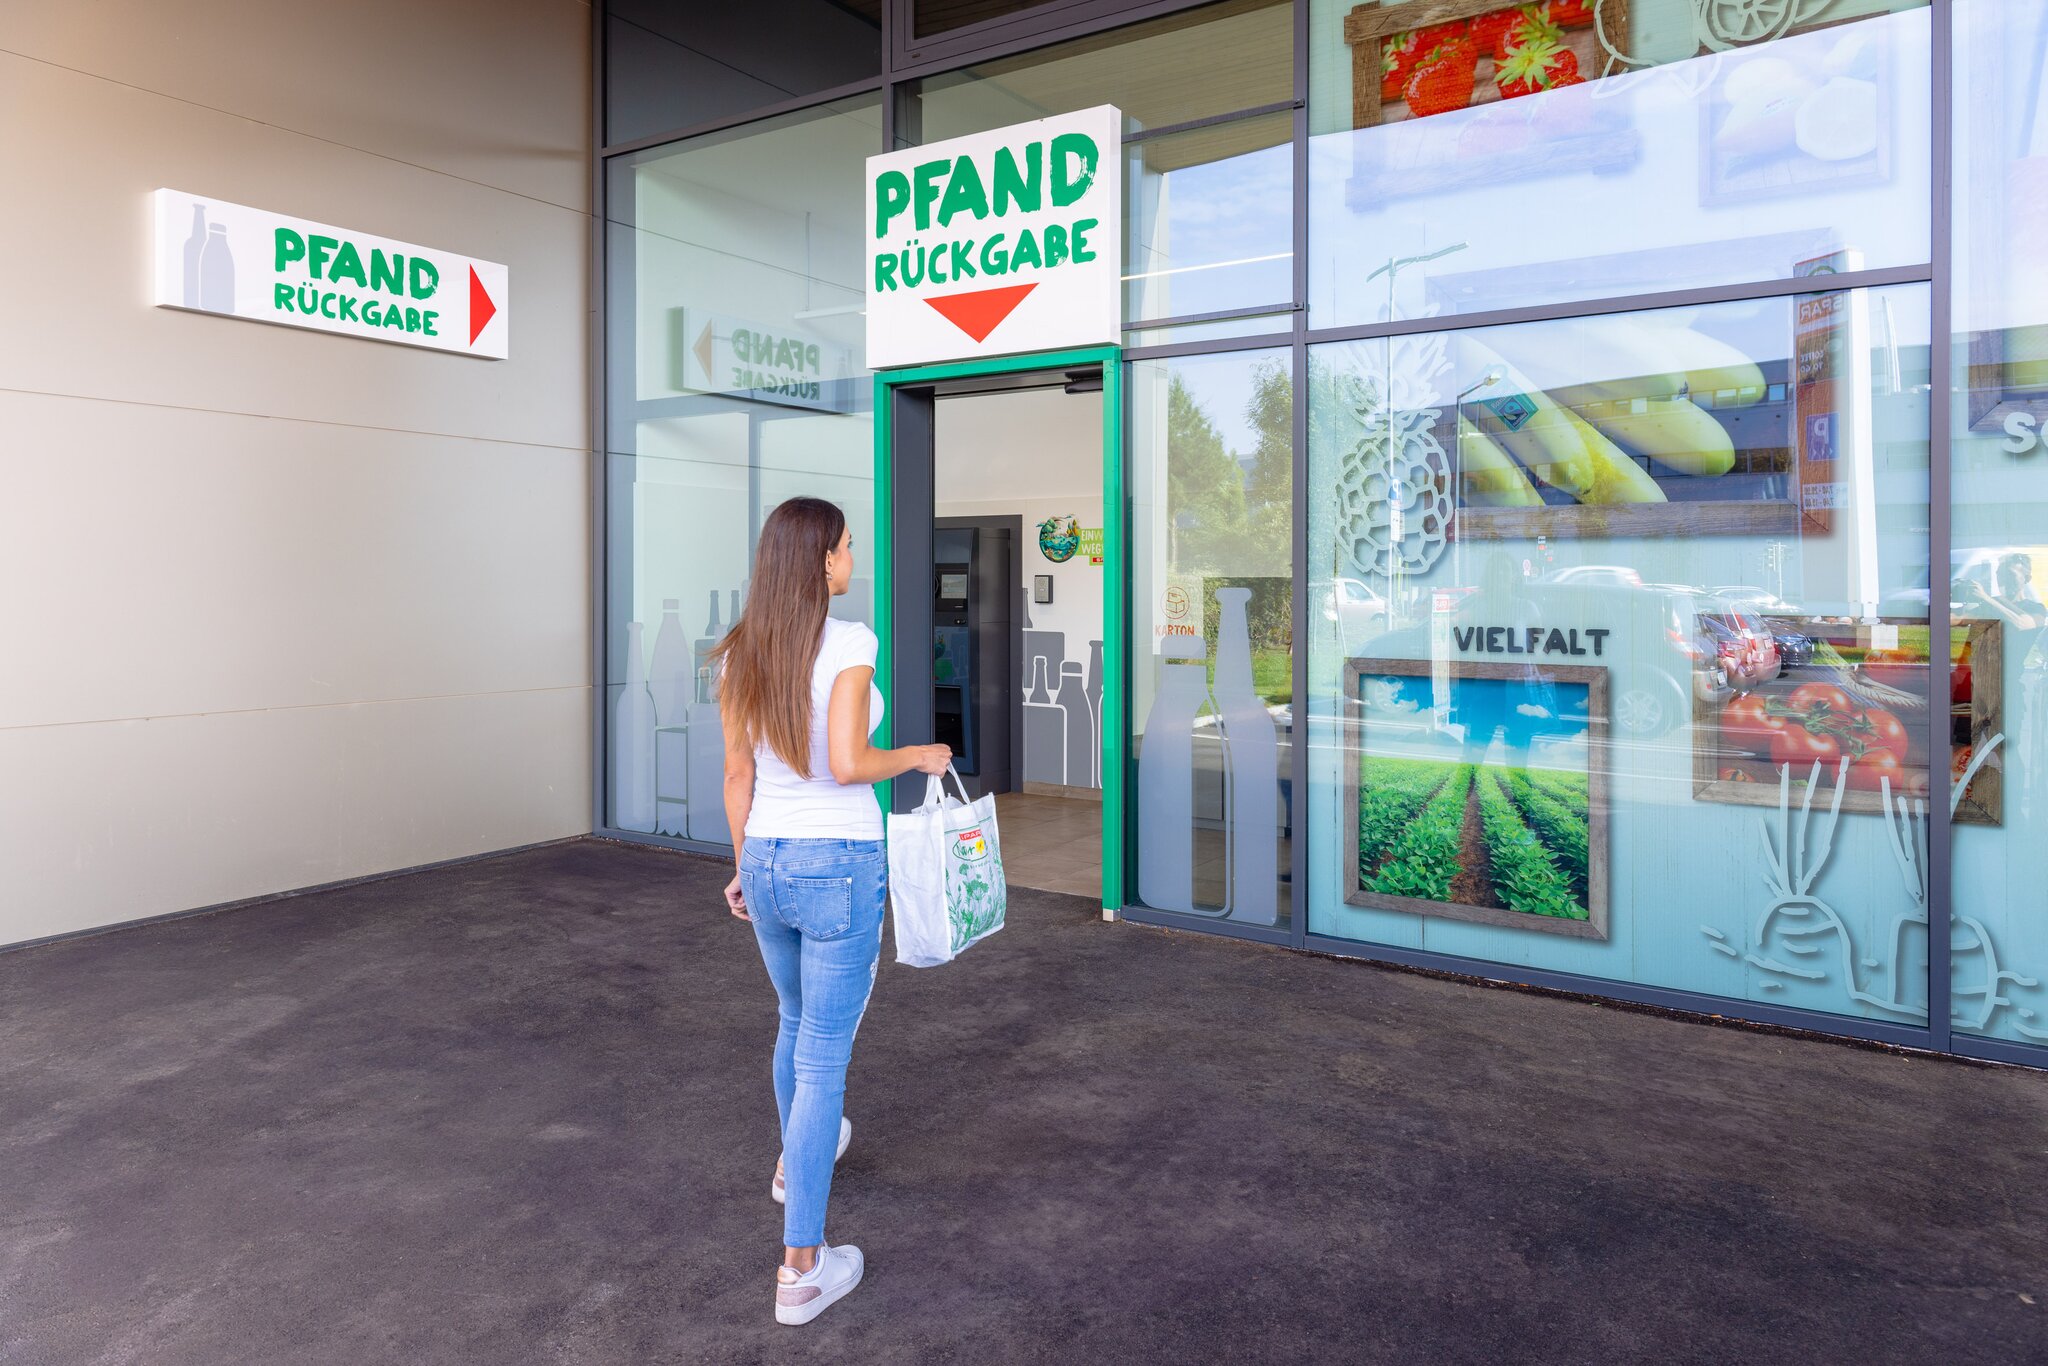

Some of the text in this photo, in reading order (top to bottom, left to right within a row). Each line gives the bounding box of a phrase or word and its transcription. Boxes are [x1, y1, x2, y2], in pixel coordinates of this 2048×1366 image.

[875, 132, 1099, 239] PFAND
[274, 227, 440, 300] PFAND
[875, 218, 1099, 292] RÜCKGABE
[274, 281, 439, 337] RÜCKGABE
[2002, 411, 2048, 454] S
[1081, 543, 1103, 554] WEG
[1155, 625, 1195, 636] KARTON
[1453, 626, 1610, 656] VIELFALT
